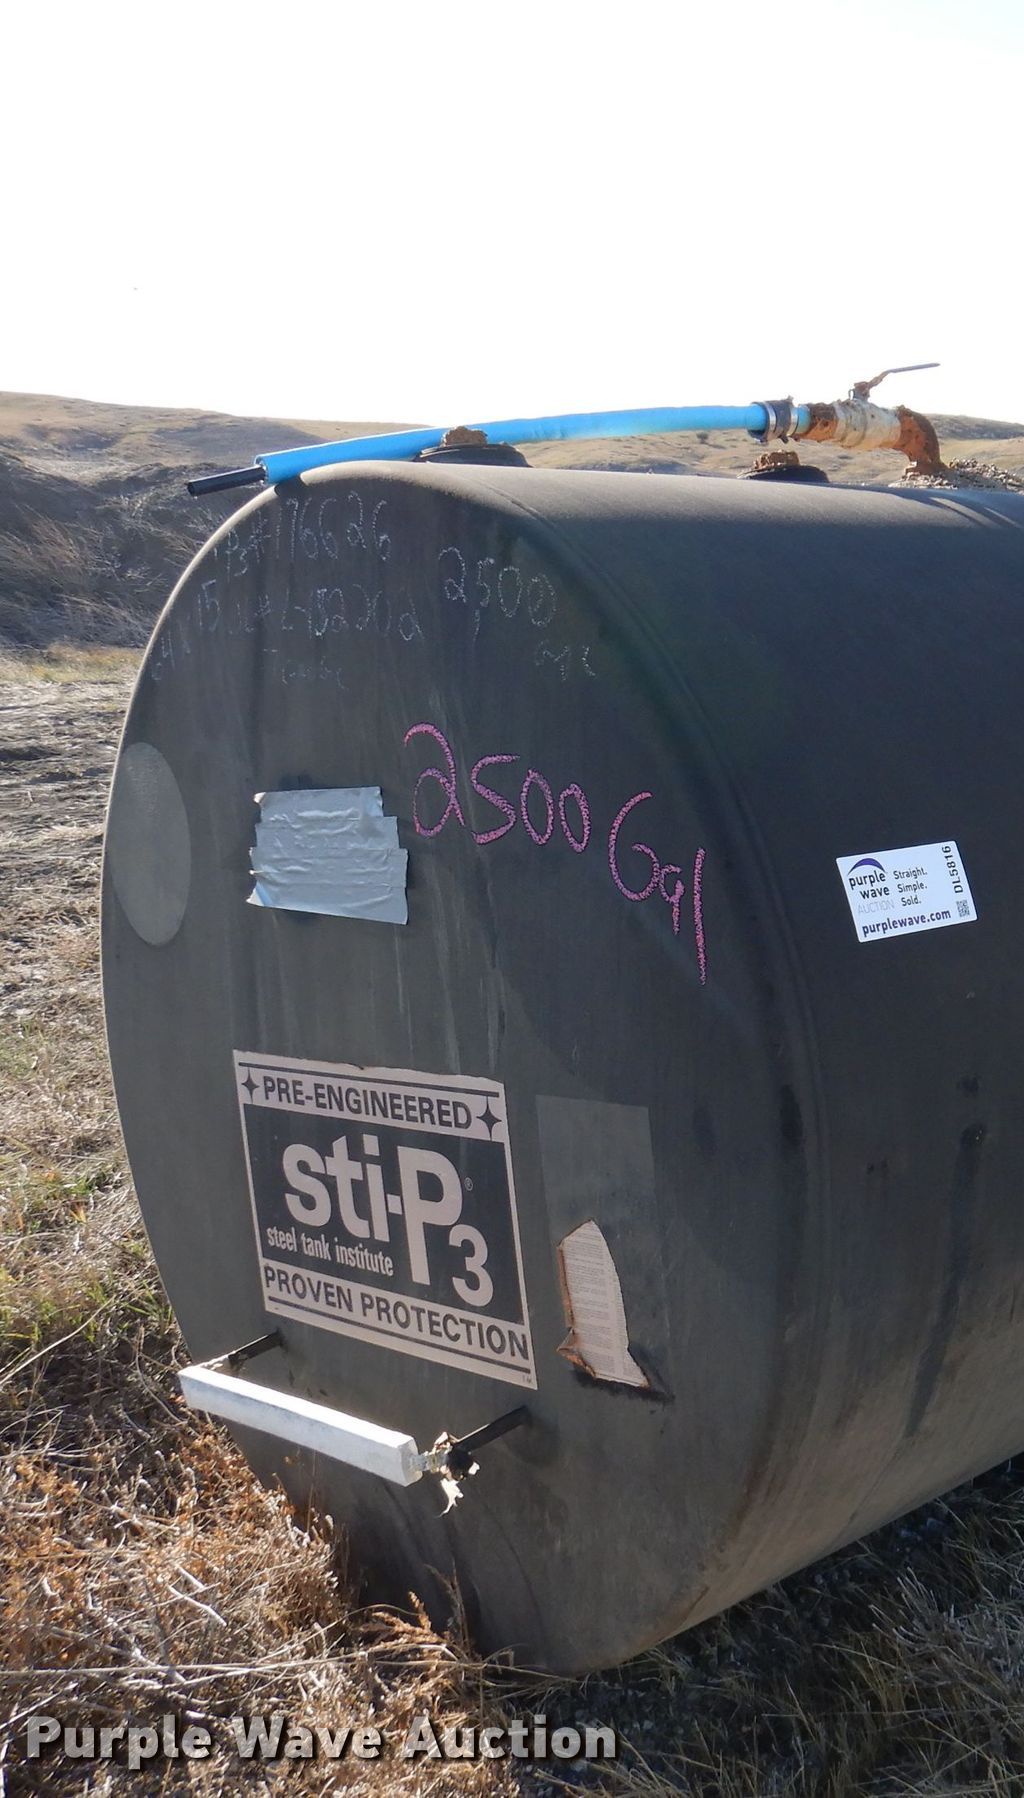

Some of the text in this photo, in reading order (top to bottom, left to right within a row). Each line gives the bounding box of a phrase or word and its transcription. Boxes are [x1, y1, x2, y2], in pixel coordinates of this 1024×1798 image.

[404, 723, 591, 853] 2500
[848, 870, 886, 890] purple
[893, 866, 928, 881] Straight.
[941, 845, 964, 894] DL5816
[860, 886, 890, 900] wave
[897, 881, 928, 894] Simple.
[901, 895, 922, 907] Sold.
[862, 909, 951, 938] purplewave.com
[262, 1075, 472, 1130] PRE-ENGINEERED
[266, 1226, 394, 1277] steel tank institute
[263, 1264, 529, 1361] PROVEN PROTECTION
